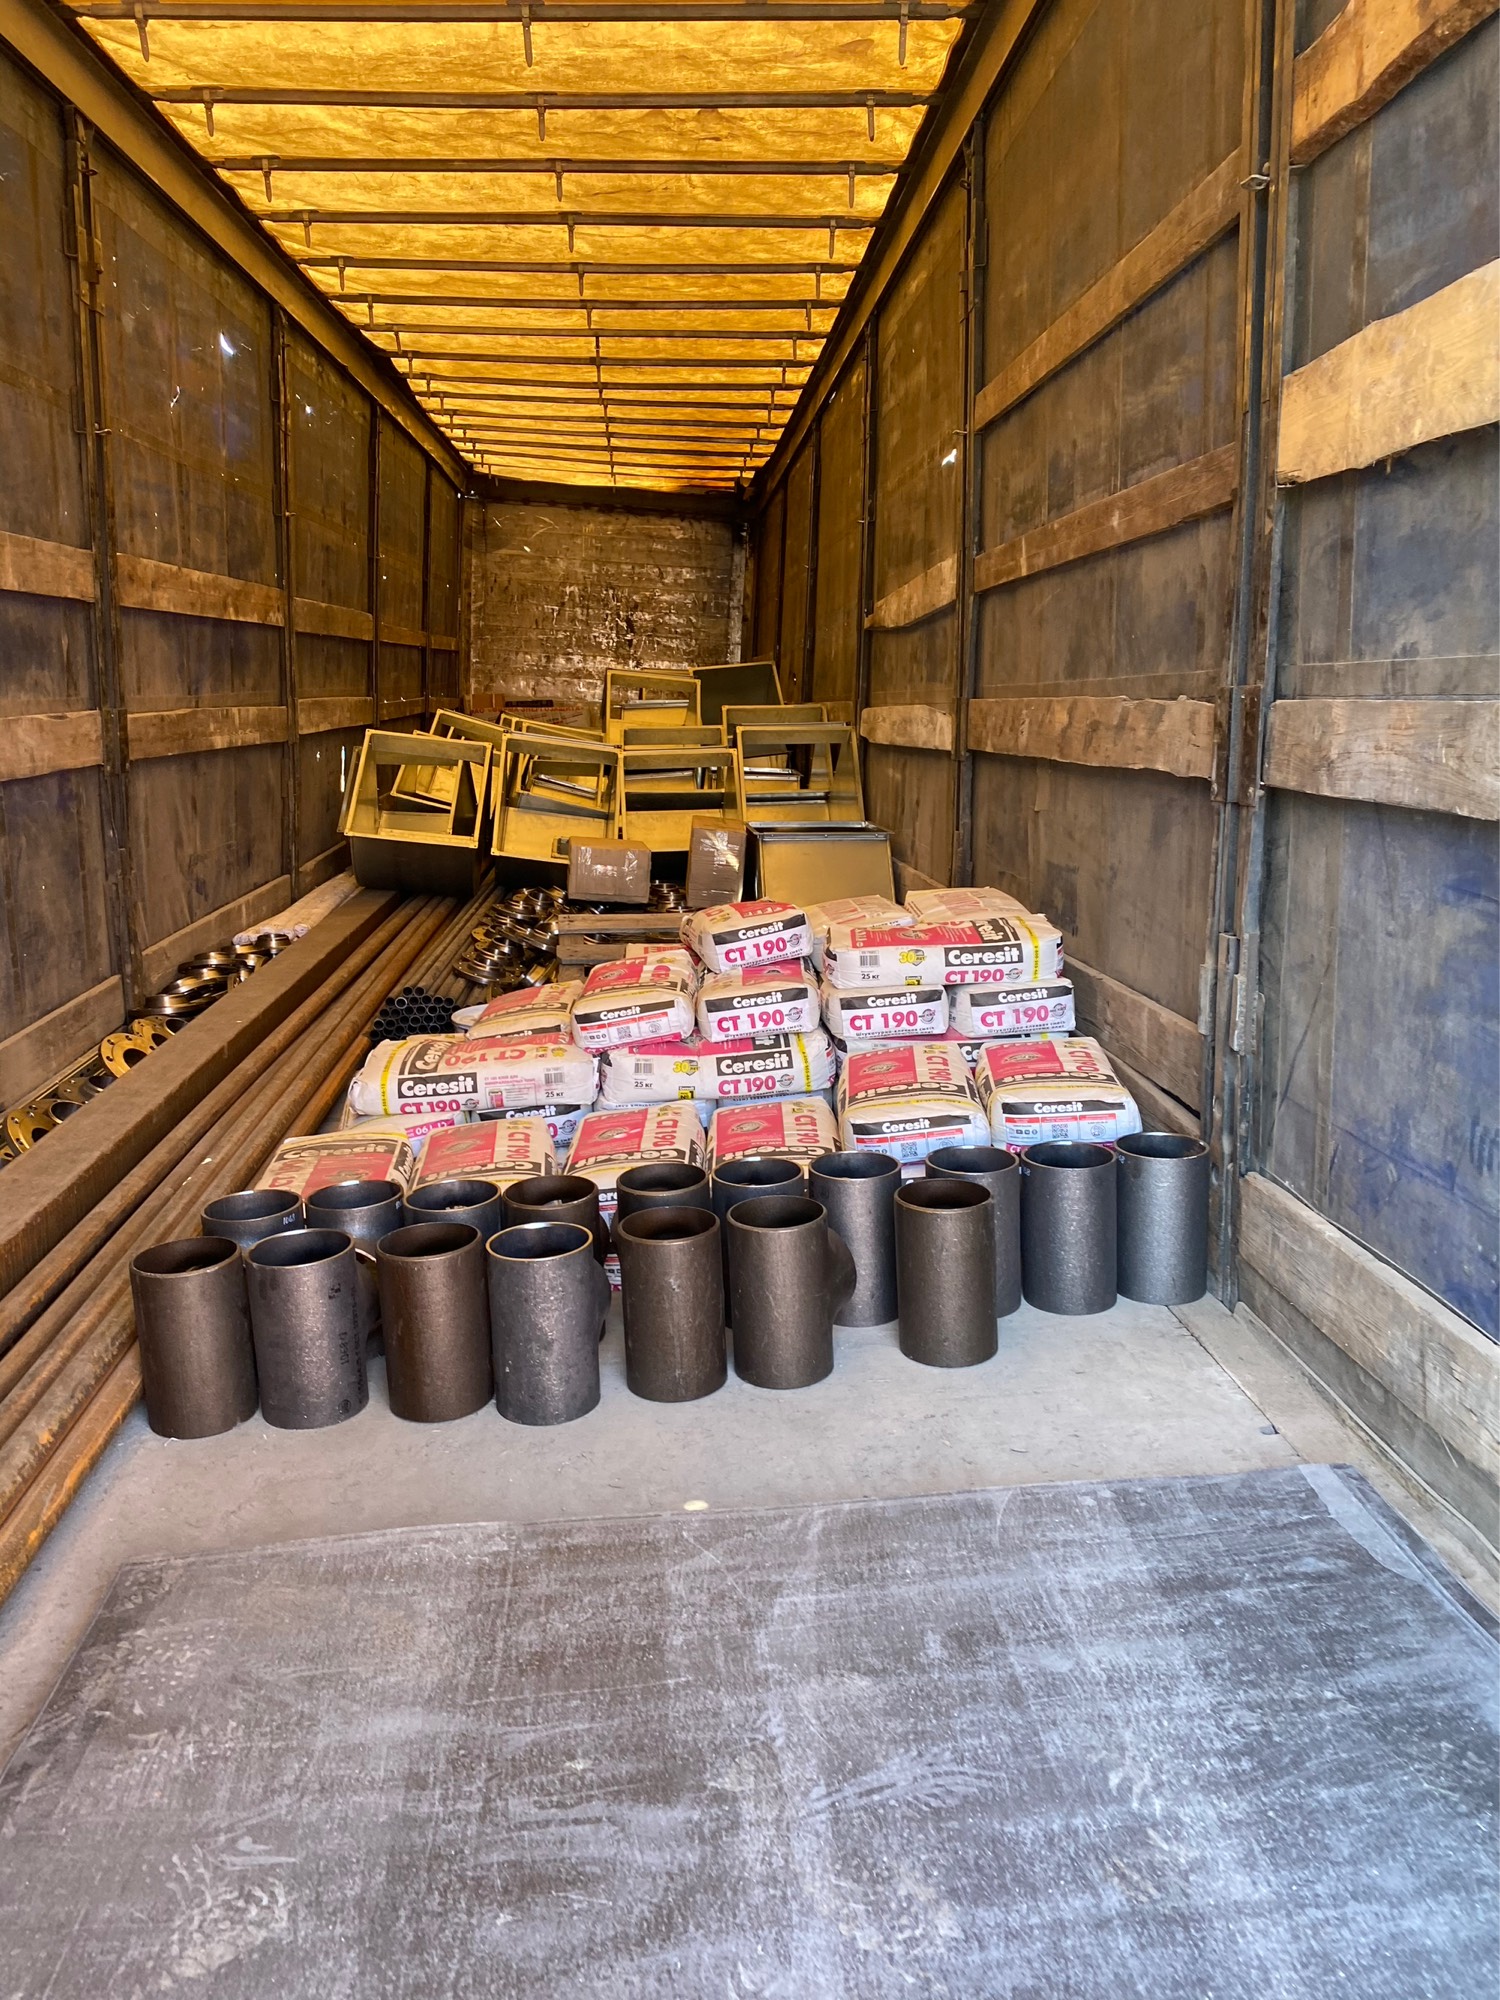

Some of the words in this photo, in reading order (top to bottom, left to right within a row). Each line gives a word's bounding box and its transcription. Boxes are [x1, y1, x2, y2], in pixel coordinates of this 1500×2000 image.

[738, 921, 784, 940] Ceresit
[724, 946, 746, 963] CT
[753, 937, 787, 958] 190
[899, 951, 916, 964] 30
[948, 946, 1020, 965] Ceresit
[945, 970, 968, 984] CT
[972, 969, 1004, 983] 190
[733, 992, 782, 1008] Ceresit
[867, 993, 918, 1007] Ceresit
[998, 988, 1048, 1003] Ceresit
[600, 1006, 641, 1020] Ceresit
[849, 1014, 874, 1031] CT
[881, 1010, 918, 1029] 190
[980, 1010, 1005, 1028] CT
[1012, 1005, 1049, 1024] 190
[717, 1015, 740, 1033] CT
[747, 1009, 785, 1030] 190
[494, 1049, 526, 1060] CT
[926, 1056, 949, 1067] CT
[673, 1061, 690, 1073] 30
[720, 1053, 790, 1074] Ceresit
[928, 1067, 952, 1081] 190
[400, 1075, 474, 1097] Ceresit
[718, 1080, 741, 1096] CT
[744, 1075, 777, 1093] 190
[855, 1082, 958, 1099] Ceresit
[400, 1102, 423, 1114] CT
[427, 1099, 461, 1113] 190
[505, 1105, 556, 1119] Ceresit
[1034, 1102, 1083, 1113] Ceresit
[795, 1114, 818, 1128] CT
[882, 1118, 930, 1132] Ceresit
[508, 1131, 530, 1143] CT
[652, 1130, 677, 1147] 190
[796, 1129, 820, 1144] 190
[283, 1143, 388, 1159] Ceresit
[506, 1144, 530, 1160] 190
[575, 1150, 678, 1168] Ceresit
